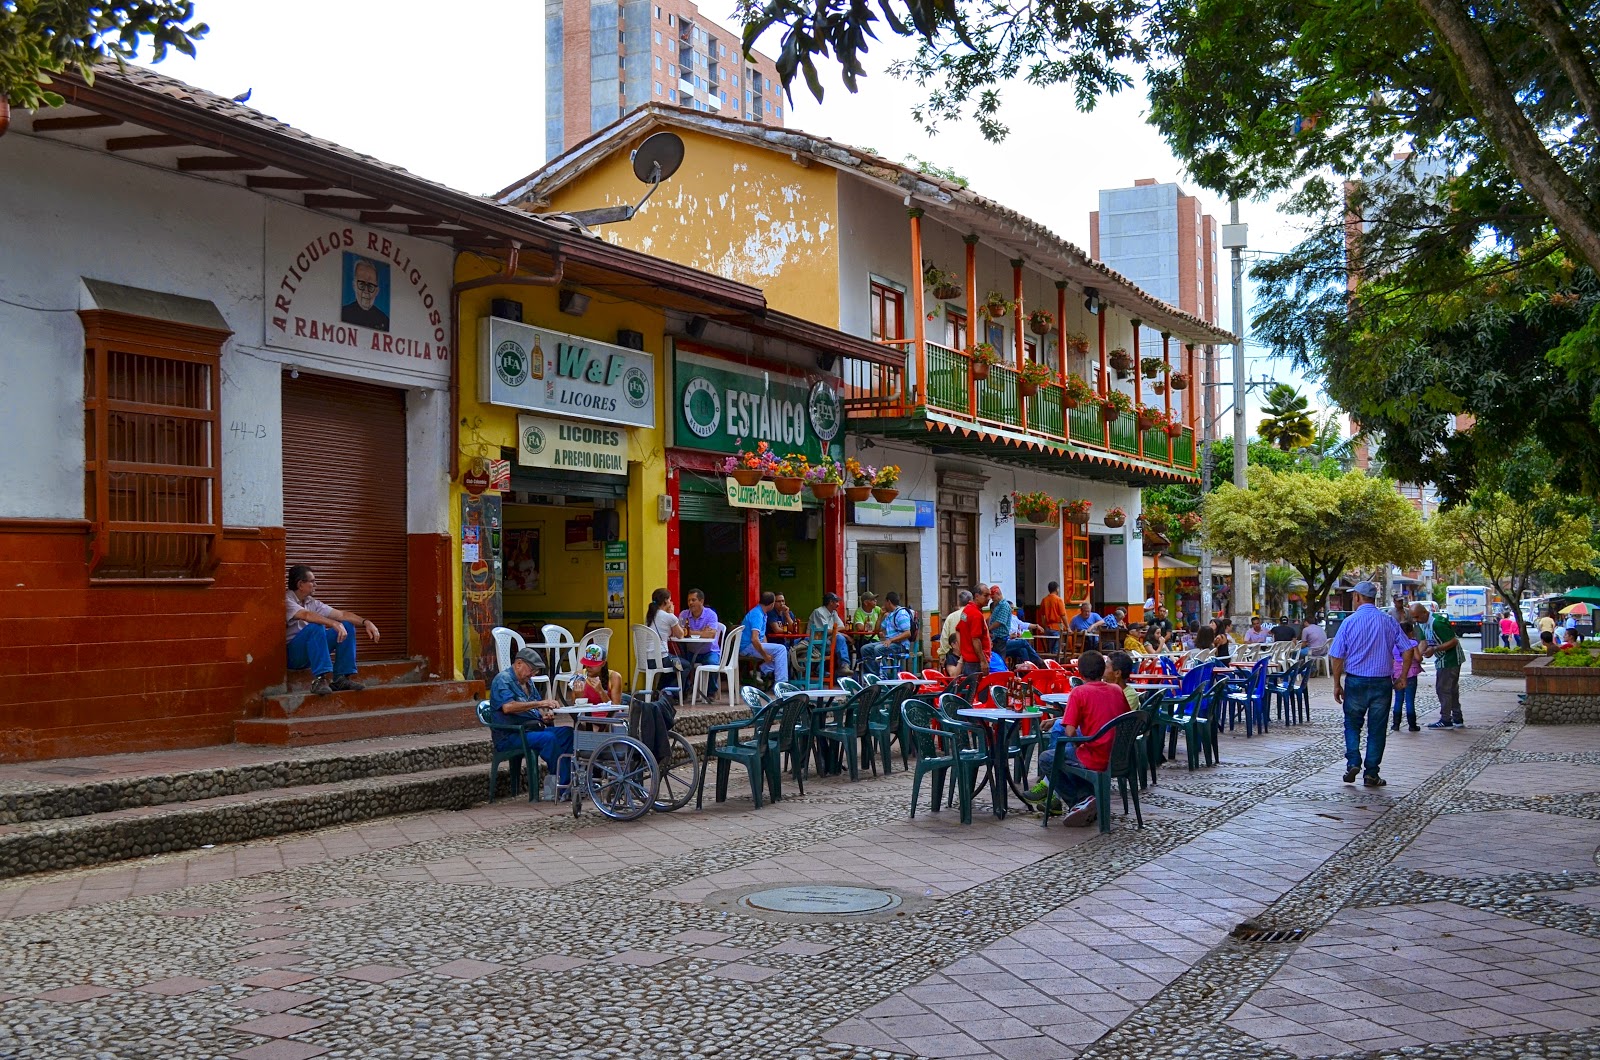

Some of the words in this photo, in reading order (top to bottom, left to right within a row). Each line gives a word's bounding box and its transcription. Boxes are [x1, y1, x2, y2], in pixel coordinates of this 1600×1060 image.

[272, 228, 354, 333] ARTICULOS
[367, 231, 448, 360] RELIGIOSOS
[295, 317, 358, 347] RAMON
[371, 332, 431, 360] ARCILA
[560, 390, 617, 412] LICORES
[726, 389, 805, 446] ESTANCO
[559, 425, 619, 447] LICORES
[554, 449, 561, 465] A
[562, 450, 591, 468] PRECIO
[593, 453, 622, 471] OFICIAL
